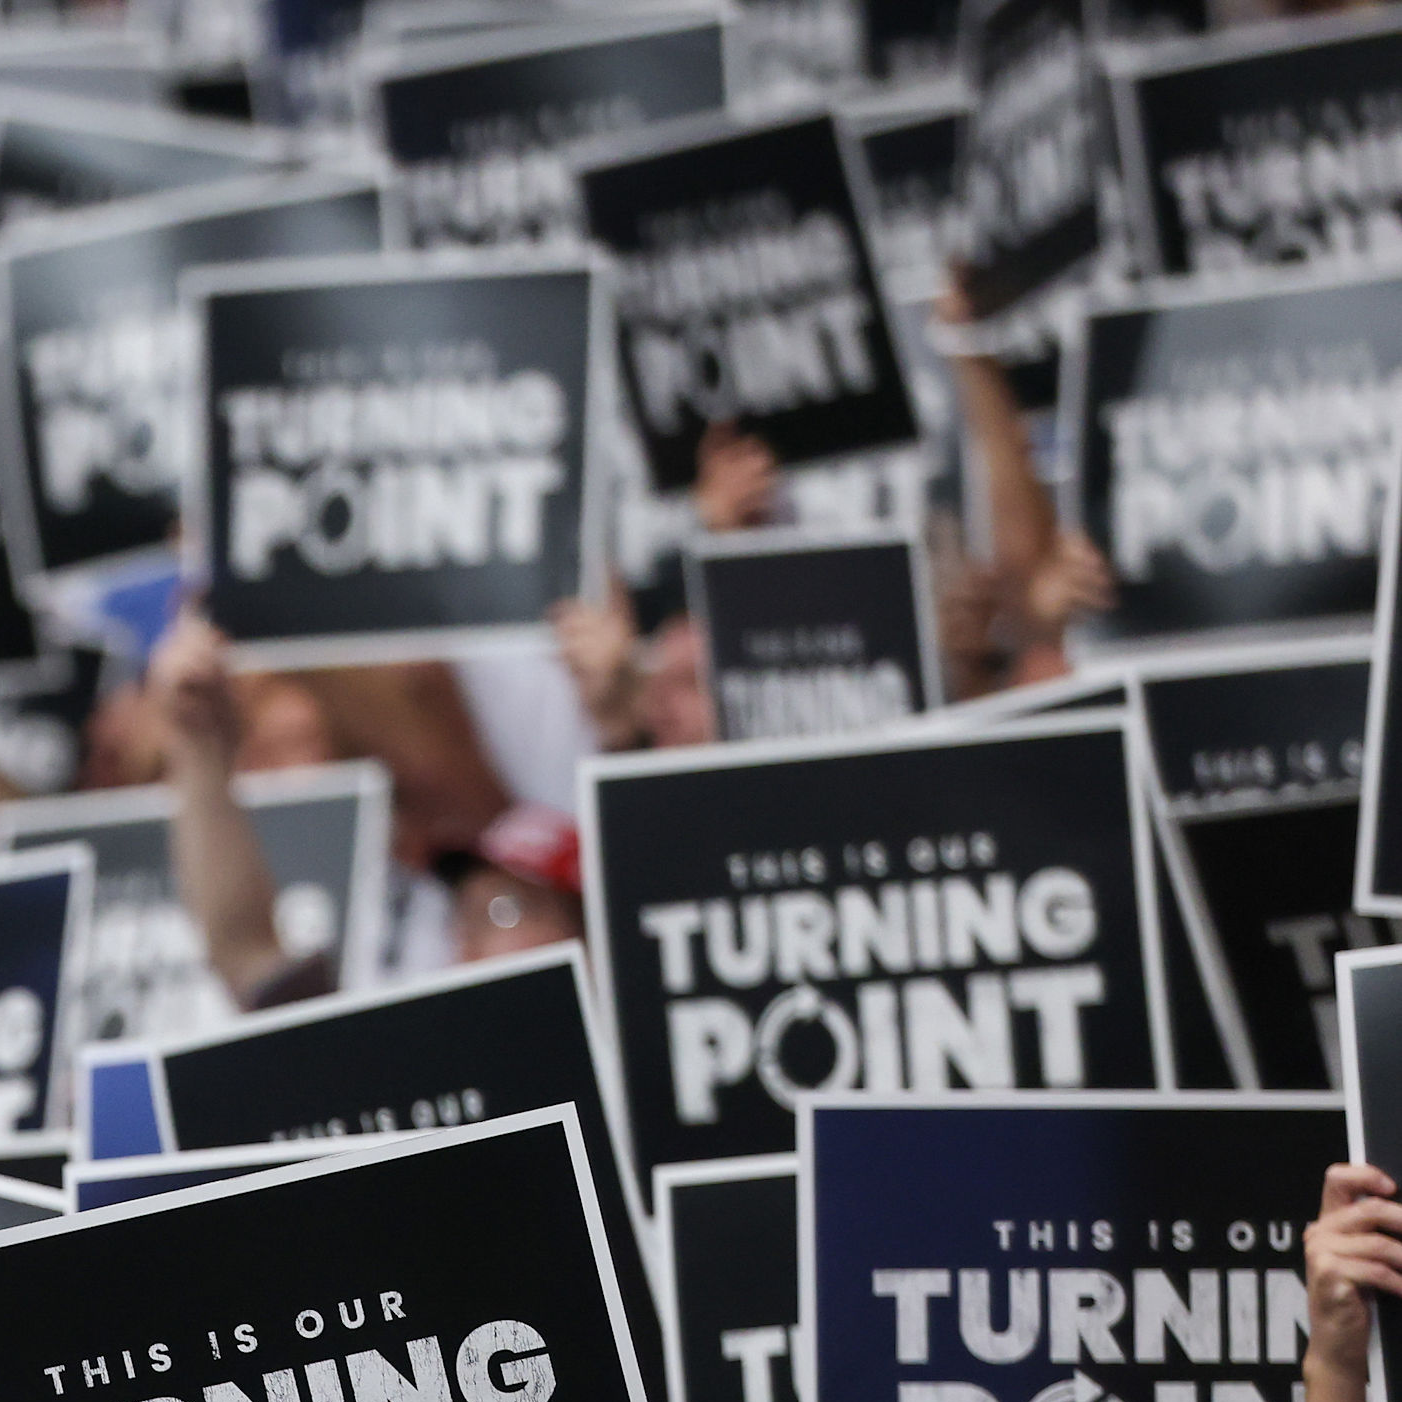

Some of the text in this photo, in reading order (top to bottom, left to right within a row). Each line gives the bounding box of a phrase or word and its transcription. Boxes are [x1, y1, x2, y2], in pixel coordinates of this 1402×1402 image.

[230, 457, 564, 580] POINT
[727, 830, 996, 887] THIS IS OUR
[640, 865, 1098, 992] TURNING
[666, 964, 1104, 1125] POINT
[994, 1219, 1308, 1252] THIS IS OU
[44, 1290, 408, 1397] THIS IS OUR
